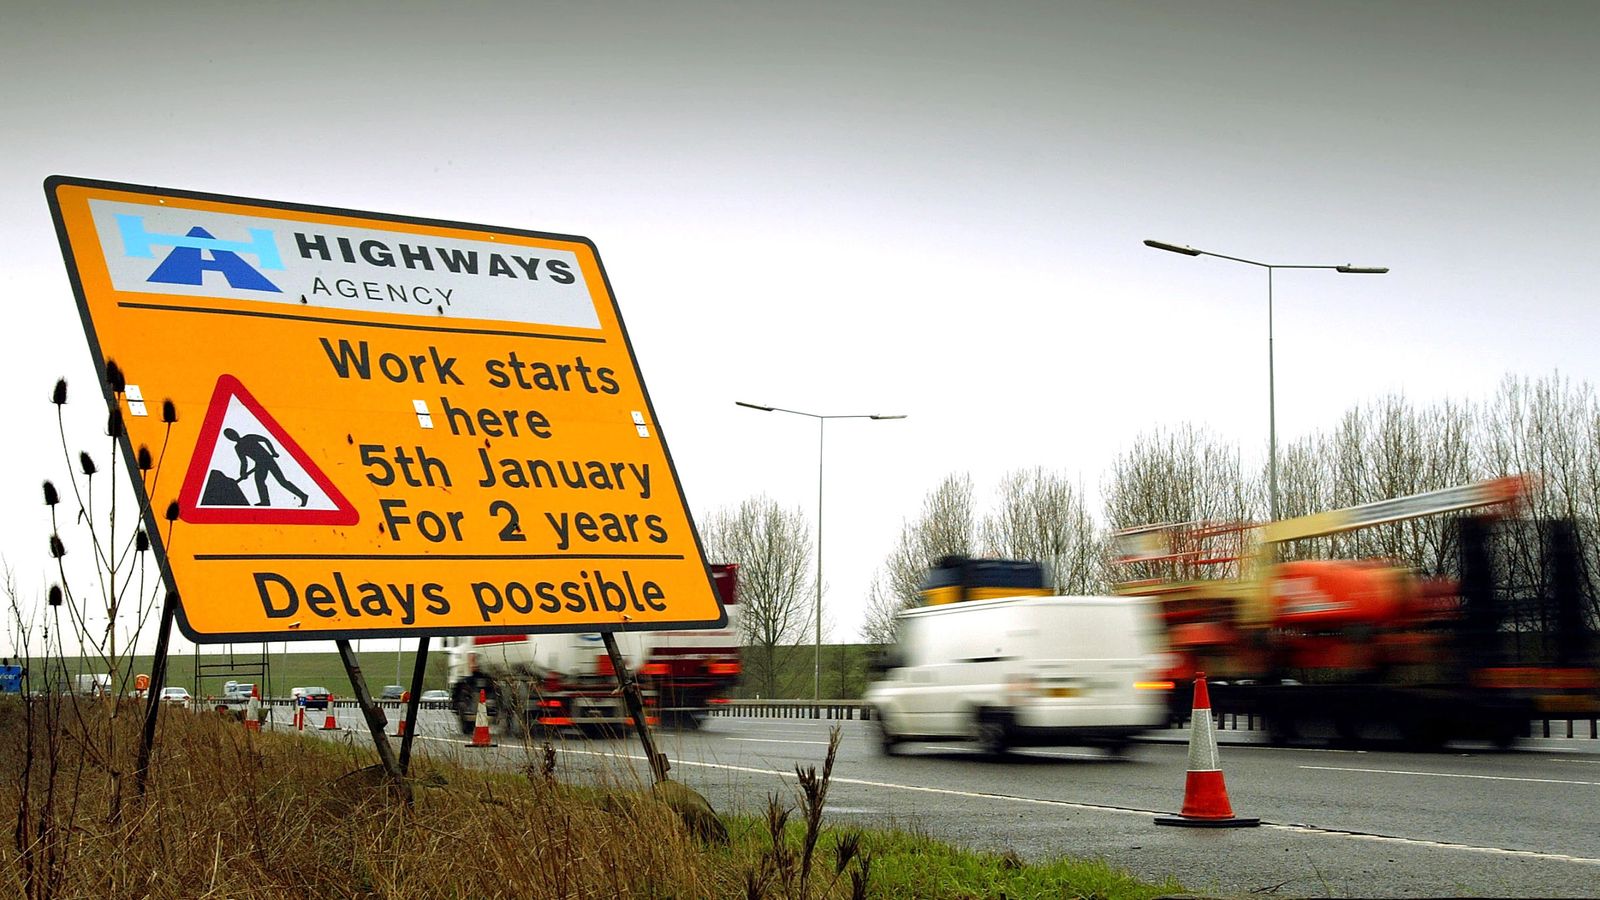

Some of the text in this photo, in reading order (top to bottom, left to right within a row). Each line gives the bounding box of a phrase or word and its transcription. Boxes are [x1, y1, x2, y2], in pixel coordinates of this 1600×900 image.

[293, 232, 576, 286] HIGHWAYS
[312, 273, 453, 306] AGENCY
[318, 336, 620, 395] Work starts
[441, 397, 551, 438] here
[360, 445, 650, 499] 5th January
[381, 499, 667, 551] For 2 years
[252, 571, 666, 626] Delays possible
